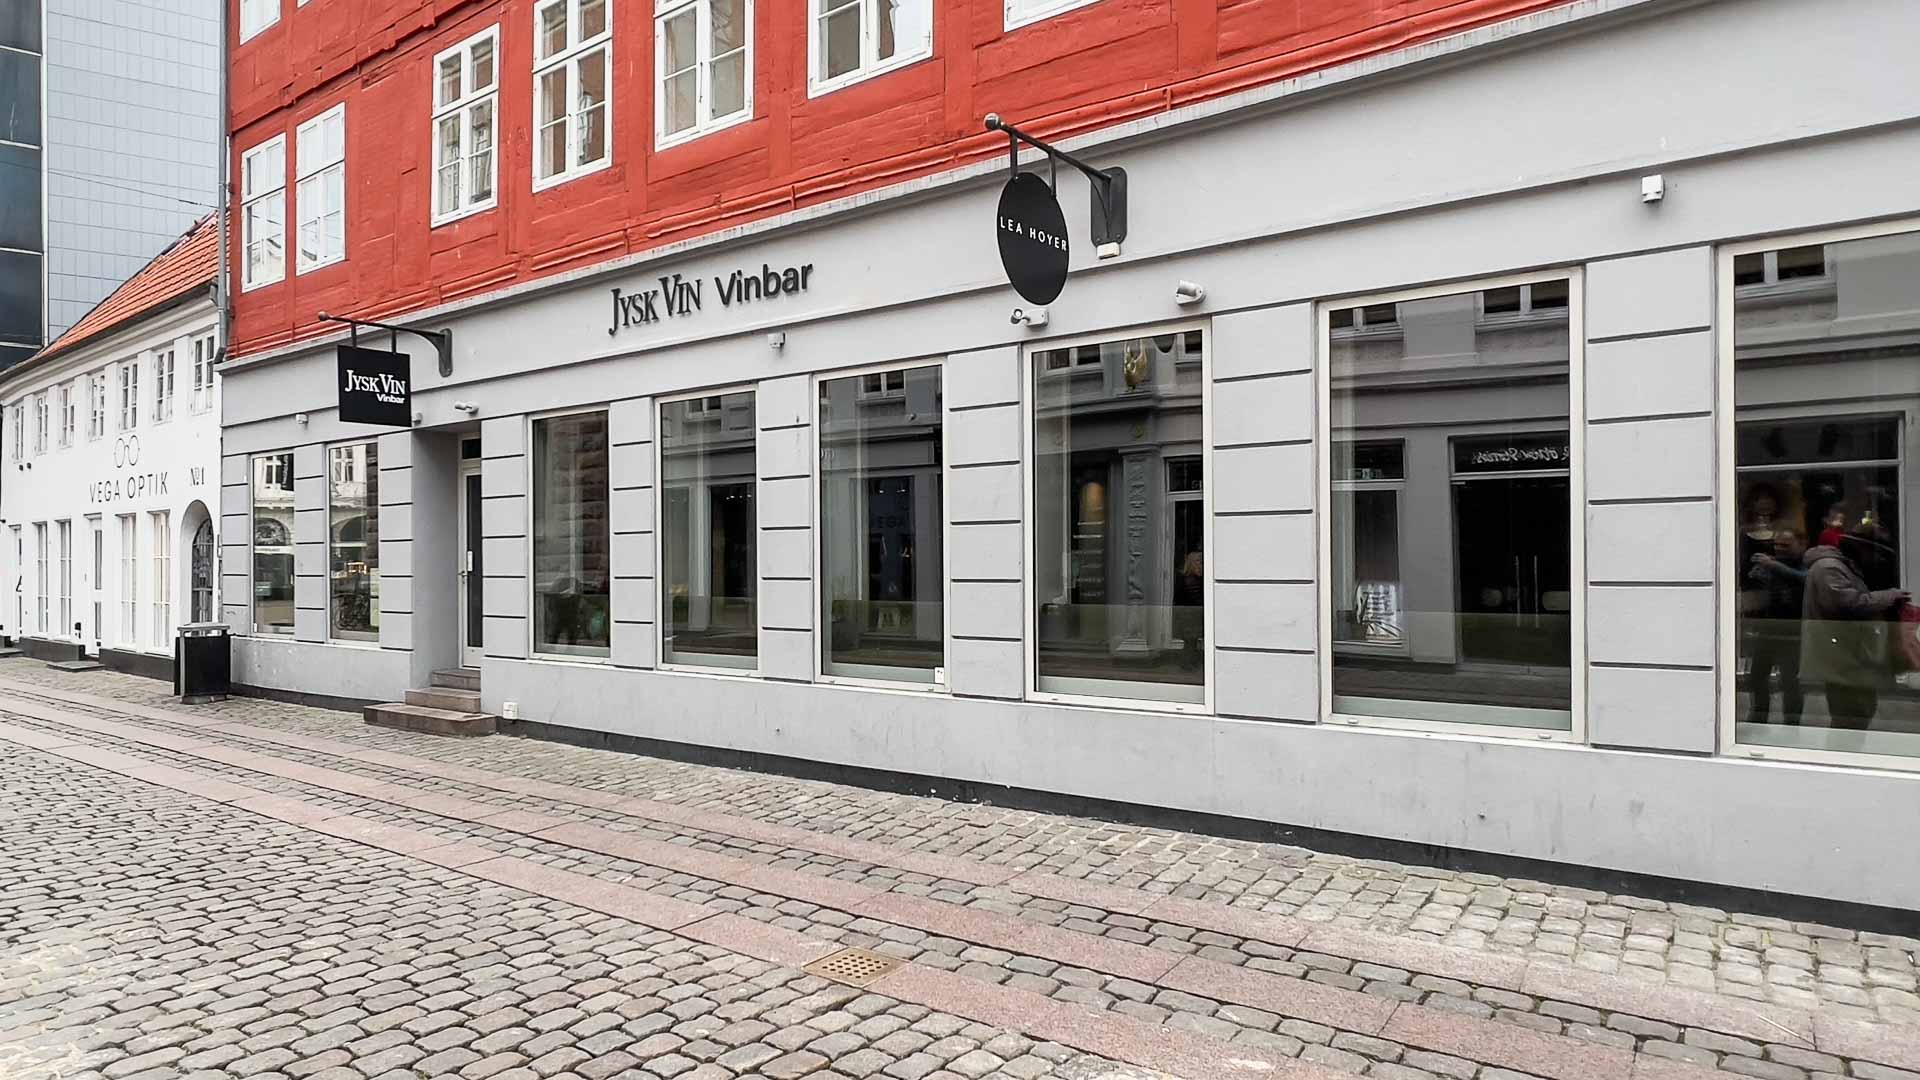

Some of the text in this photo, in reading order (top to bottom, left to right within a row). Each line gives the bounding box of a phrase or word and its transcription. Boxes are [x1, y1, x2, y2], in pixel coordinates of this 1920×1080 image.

[1000, 216, 1067, 251] LEA HOYER
[715, 263, 813, 306] Vinbar
[376, 393, 405, 404] Vinbar
[89, 471, 169, 503] VEGA OPTIK
